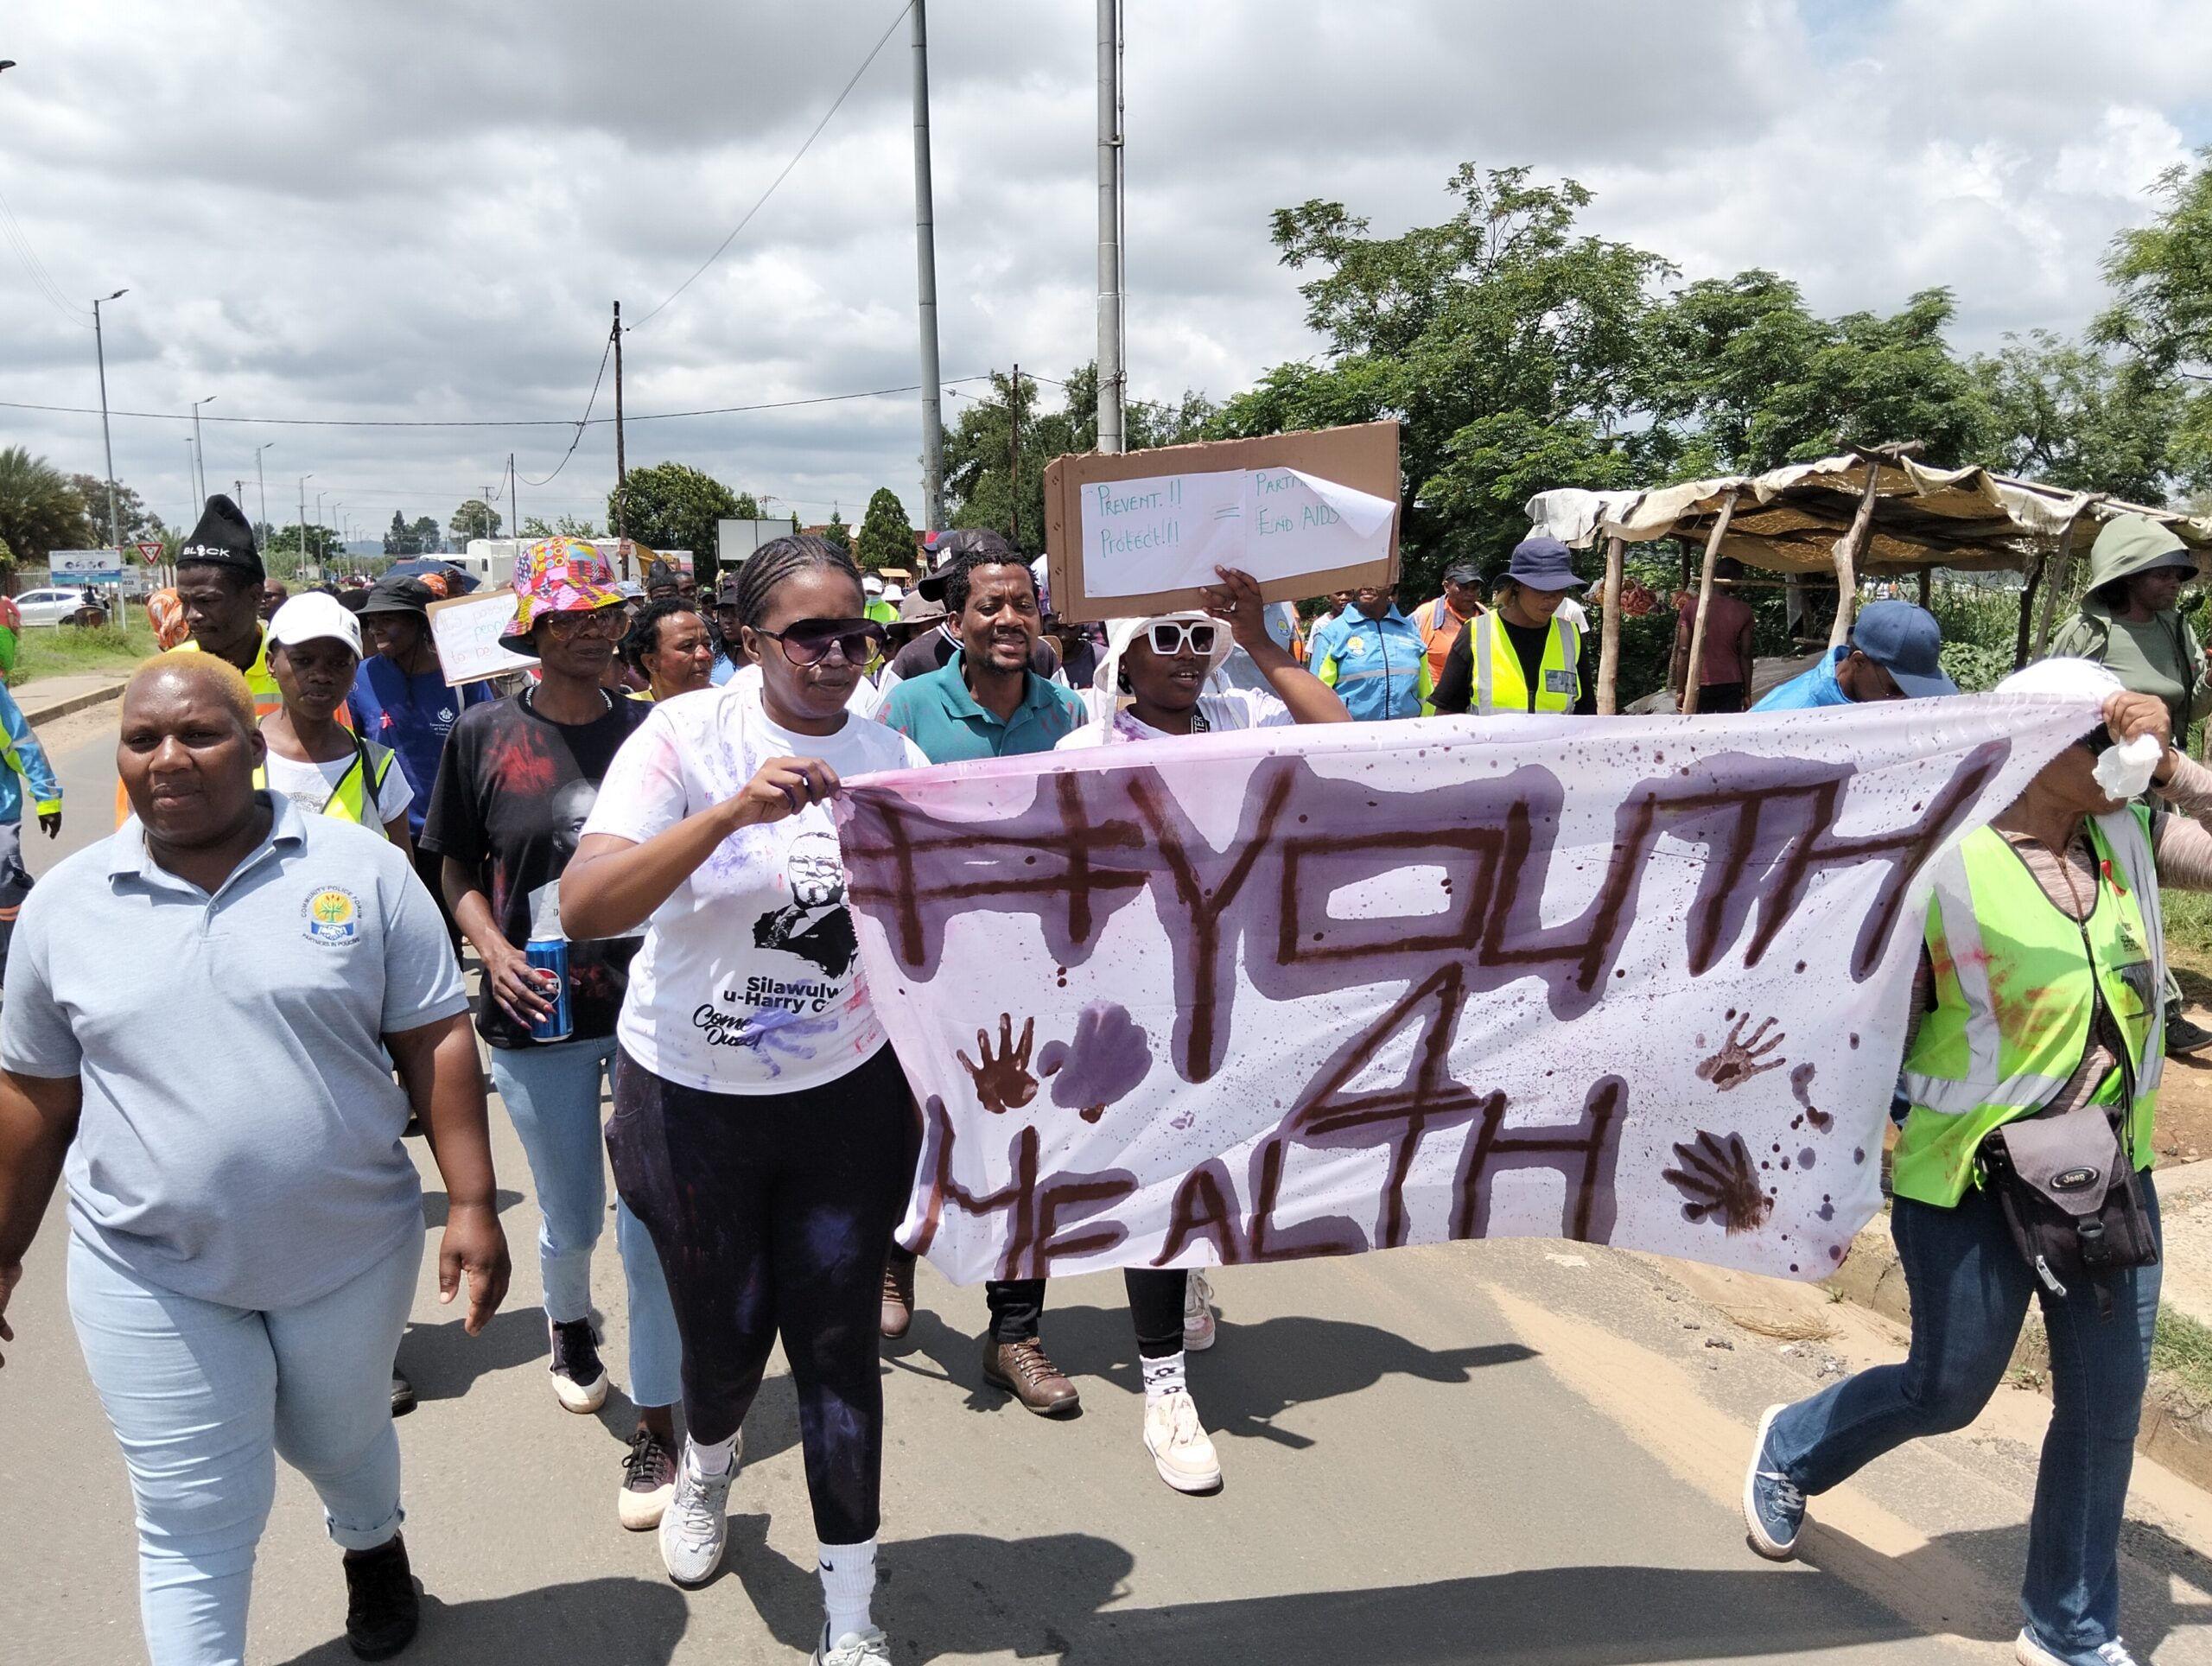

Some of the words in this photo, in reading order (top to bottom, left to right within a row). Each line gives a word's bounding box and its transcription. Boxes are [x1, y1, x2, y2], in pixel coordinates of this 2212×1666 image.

[1255, 472, 1310, 497] PARTN
[474, 616, 507, 643] peopl
[1193, 714, 1206, 734] TER
[301, 886, 326, 919] COMMUNITY
[327, 885, 353, 896] POLICE
[302, 932, 329, 947] PARTNERS
[723, 989, 805, 1014] u-Harry
[693, 1003, 754, 1032] Come
[1290, 961, 1485, 1135] 4
[899, 1074, 1628, 1281] HEALTH
[2063, 1173, 2086, 1184] Jeep
